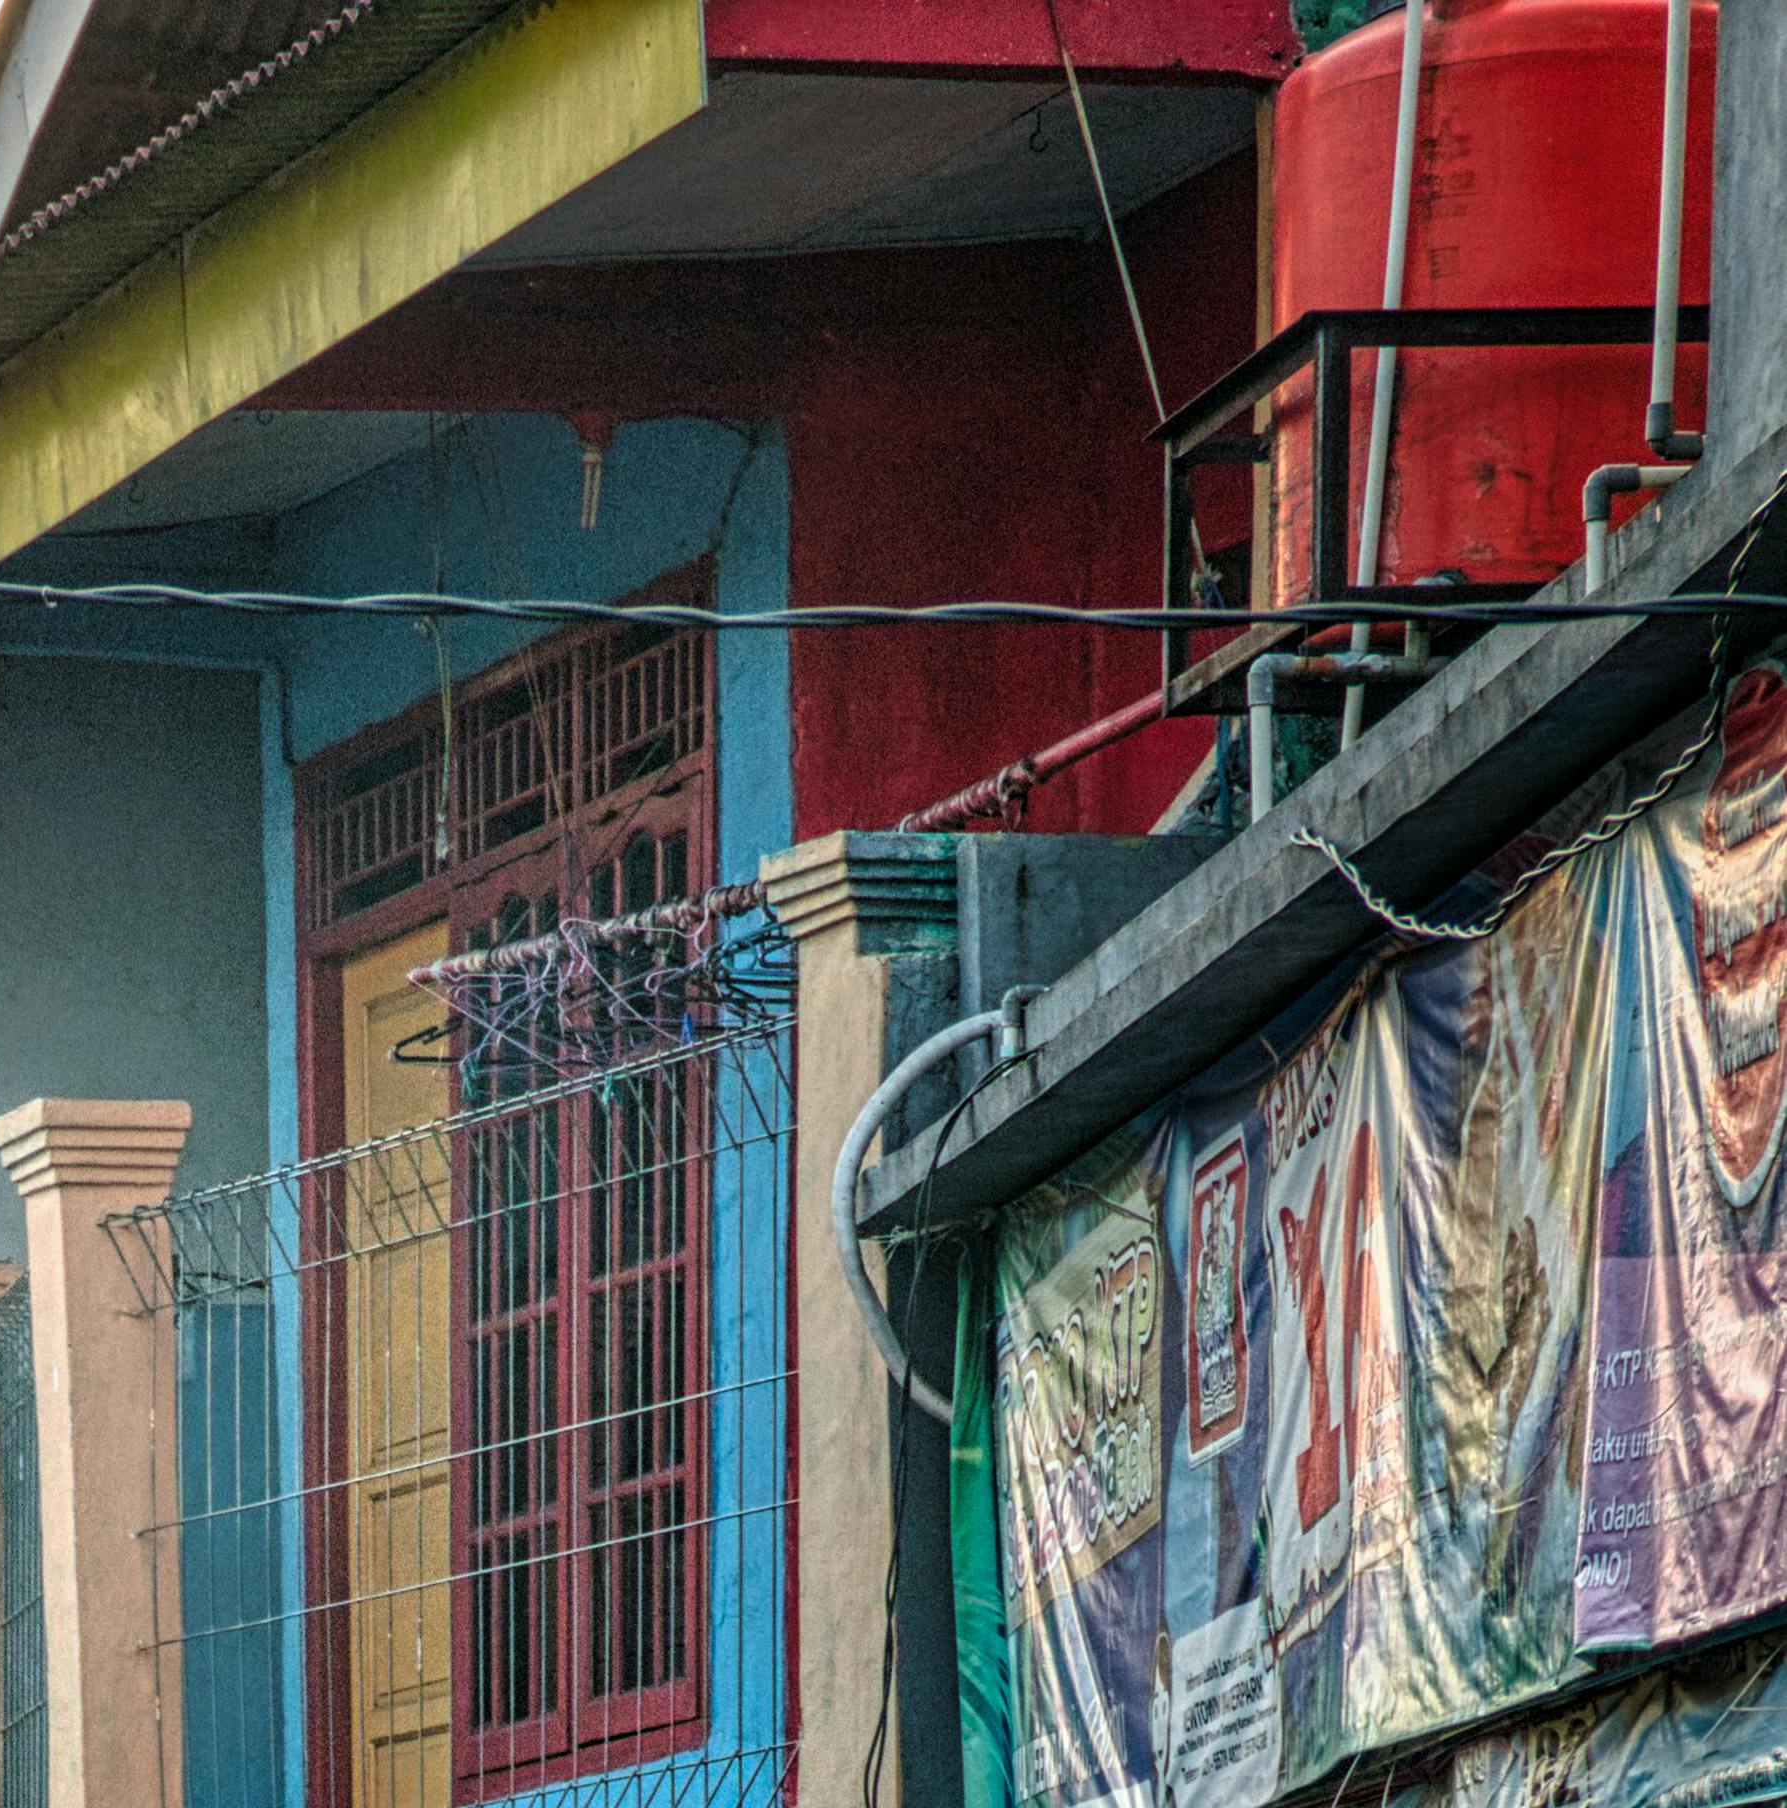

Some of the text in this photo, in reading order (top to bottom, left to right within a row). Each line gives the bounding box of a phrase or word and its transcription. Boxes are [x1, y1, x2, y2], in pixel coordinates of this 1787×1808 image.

[1093, 1235, 1160, 1423] KTP
[1604, 1351, 1641, 1390] KTP
[1603, 1492, 1652, 1538] dapat
